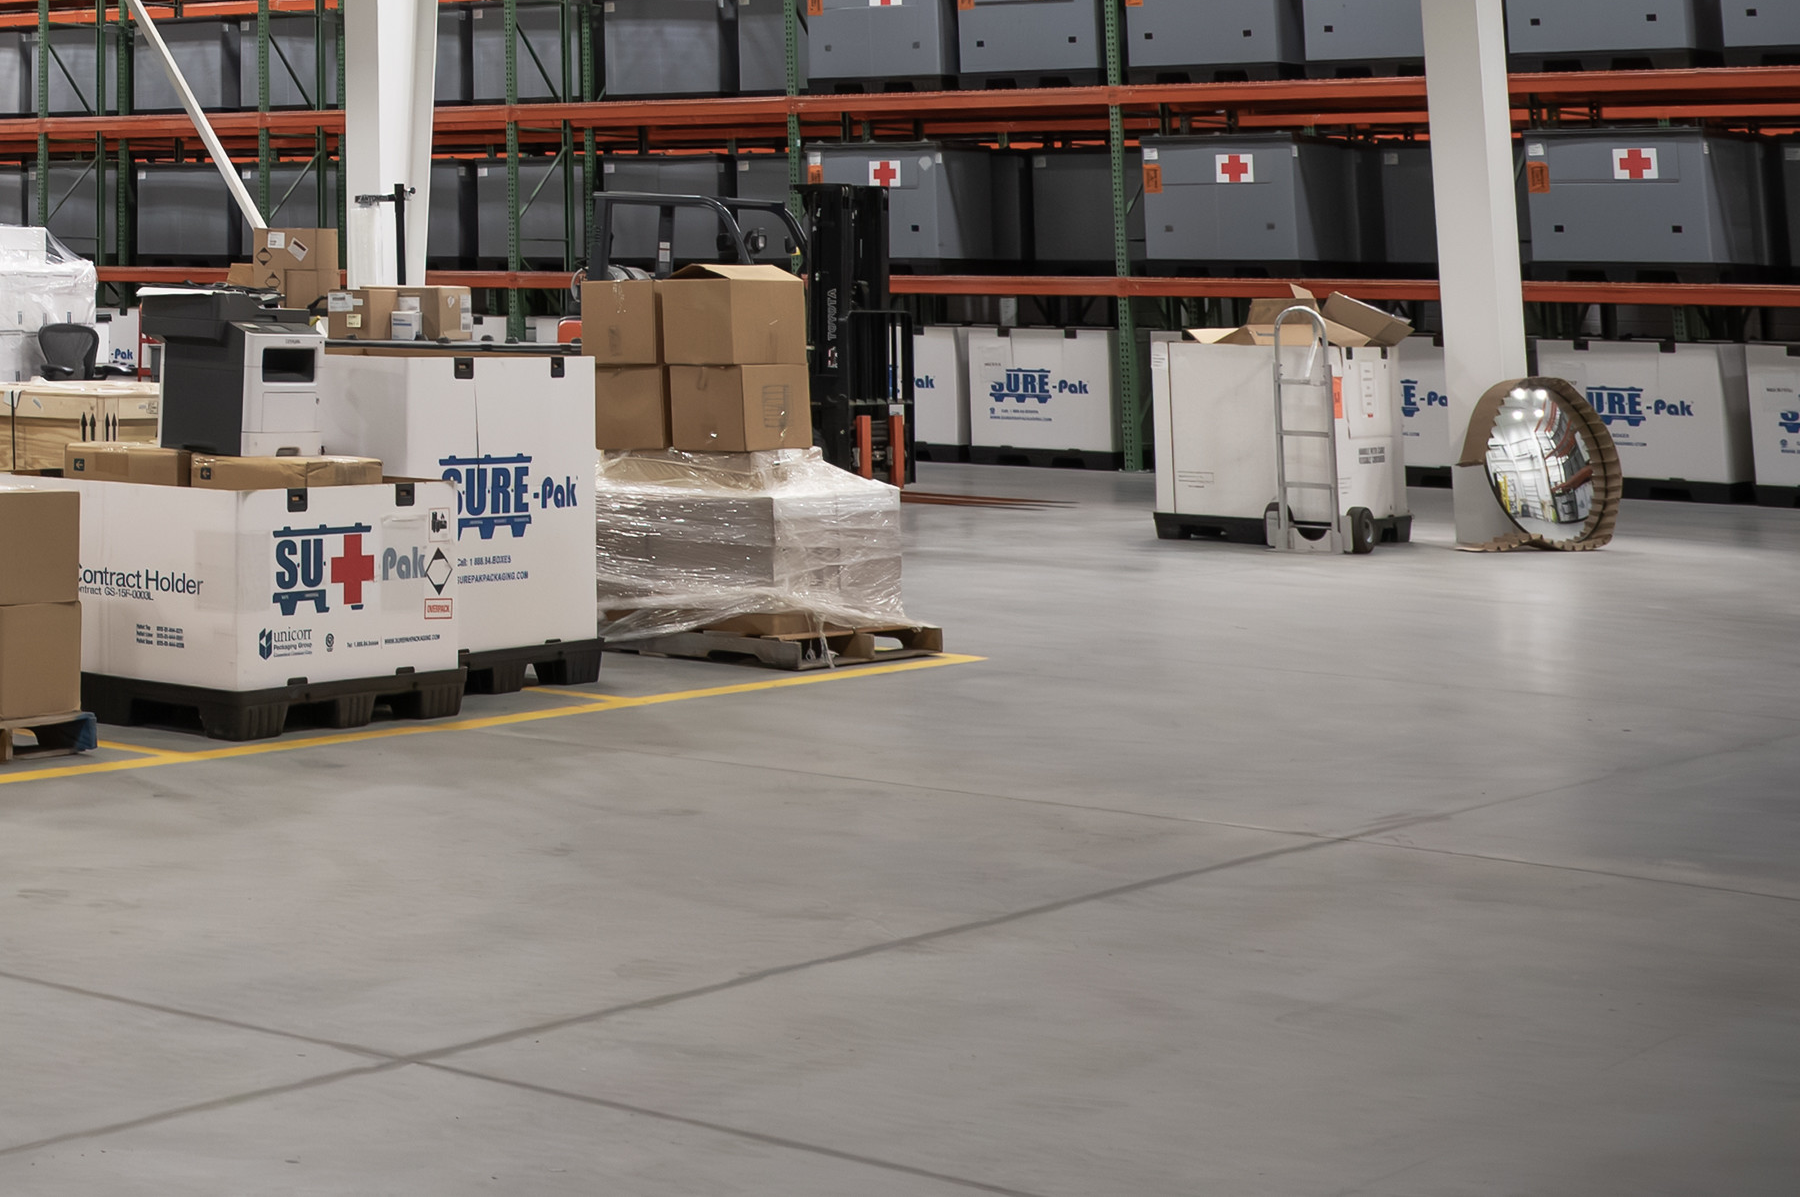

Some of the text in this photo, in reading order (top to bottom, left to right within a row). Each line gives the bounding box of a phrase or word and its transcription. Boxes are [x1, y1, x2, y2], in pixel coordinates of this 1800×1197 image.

[827, 288, 837, 341] TOYOTA
[79, 585, 102, 596] ntract
[145, 569, 204, 596] Holder
[274, 626, 312, 643] unicorr
